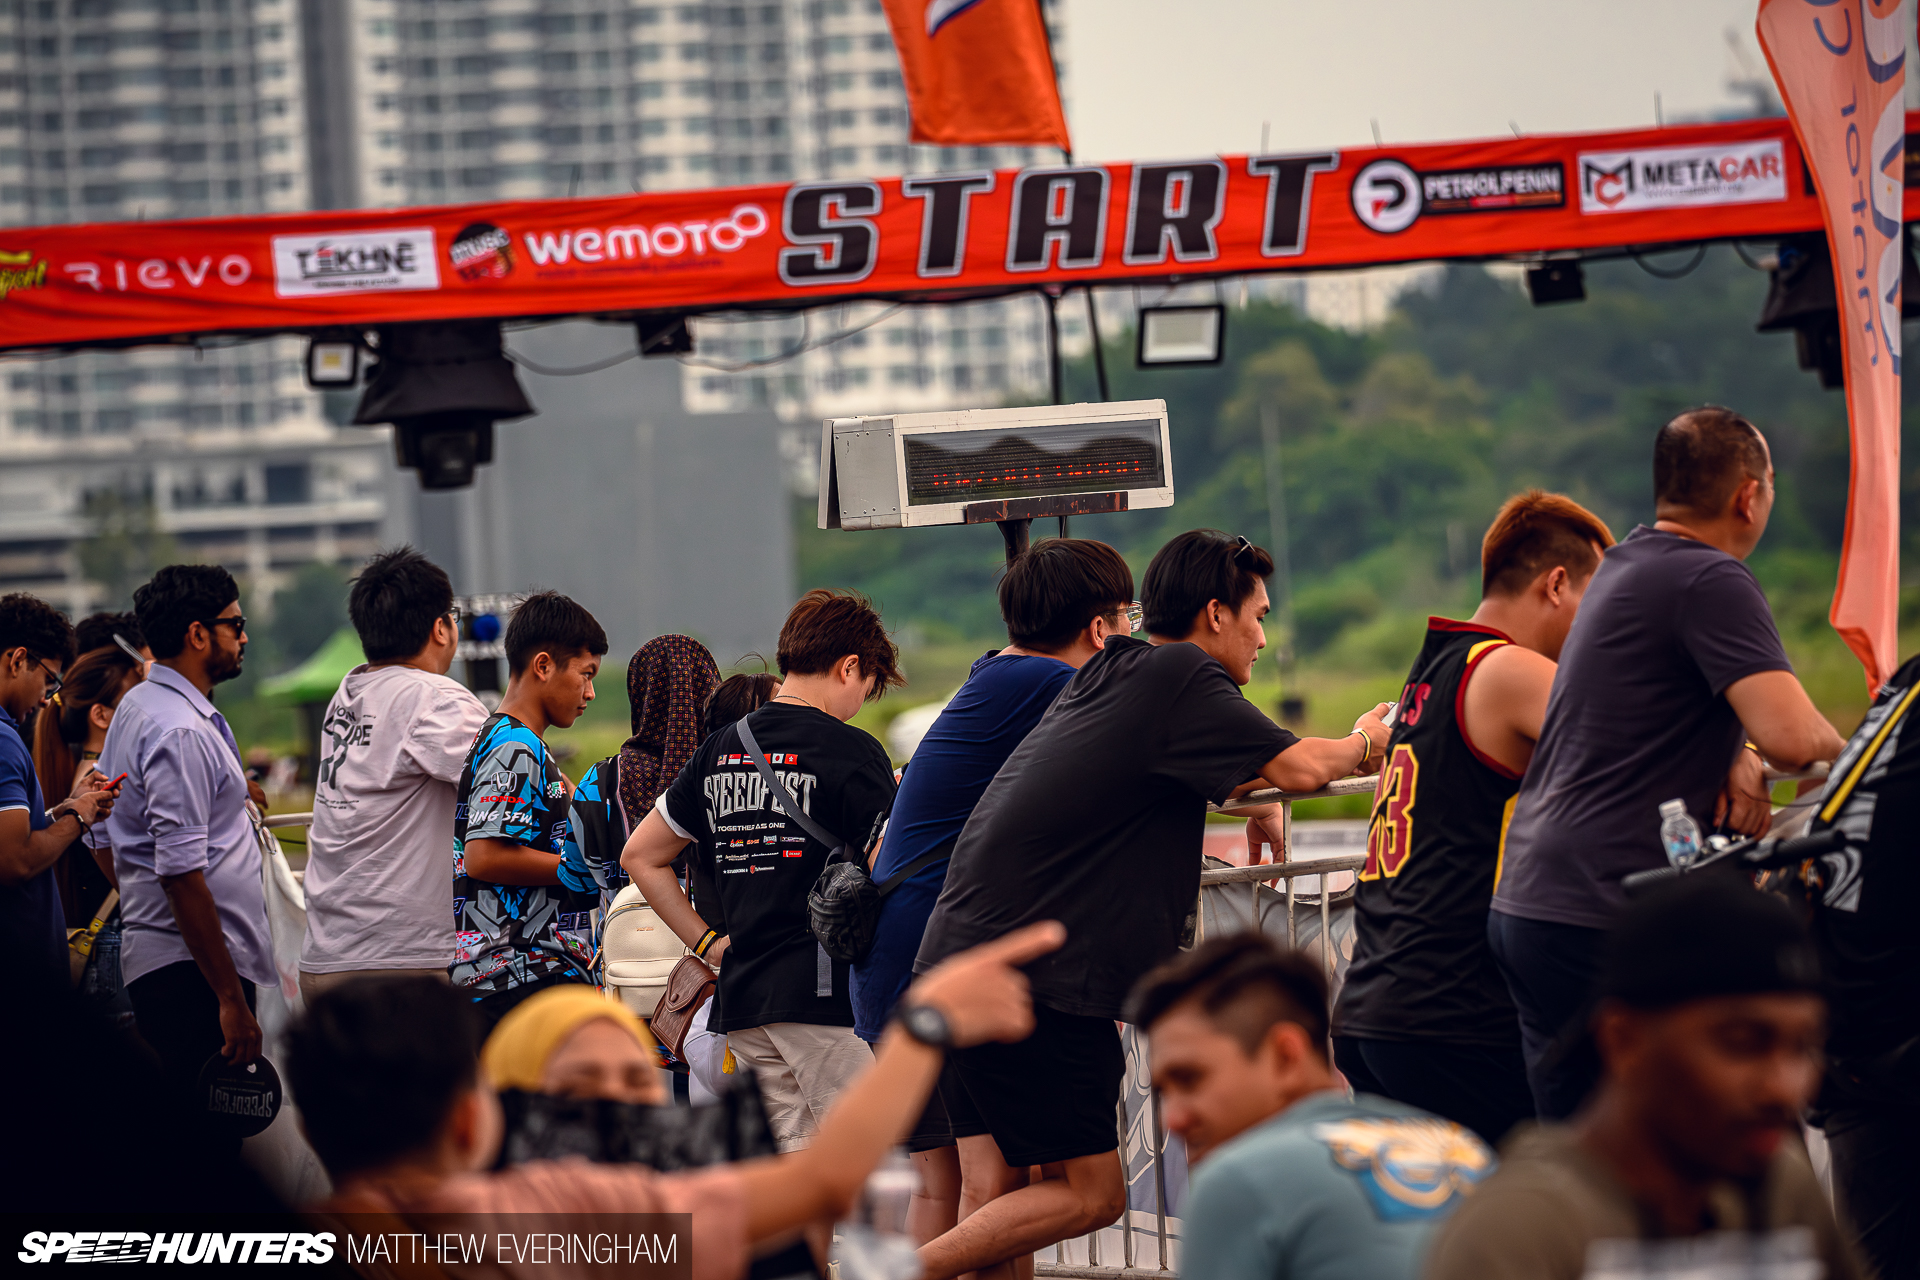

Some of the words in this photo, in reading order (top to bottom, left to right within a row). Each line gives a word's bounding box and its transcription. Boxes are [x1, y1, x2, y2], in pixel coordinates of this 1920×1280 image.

[1643, 154, 1780, 187] METACAR
[778, 152, 1339, 287] START
[480, 795, 526, 804] HONDA
[754, 822, 768, 830] AS
[209, 1084, 273, 1118] SPEEDFEST
